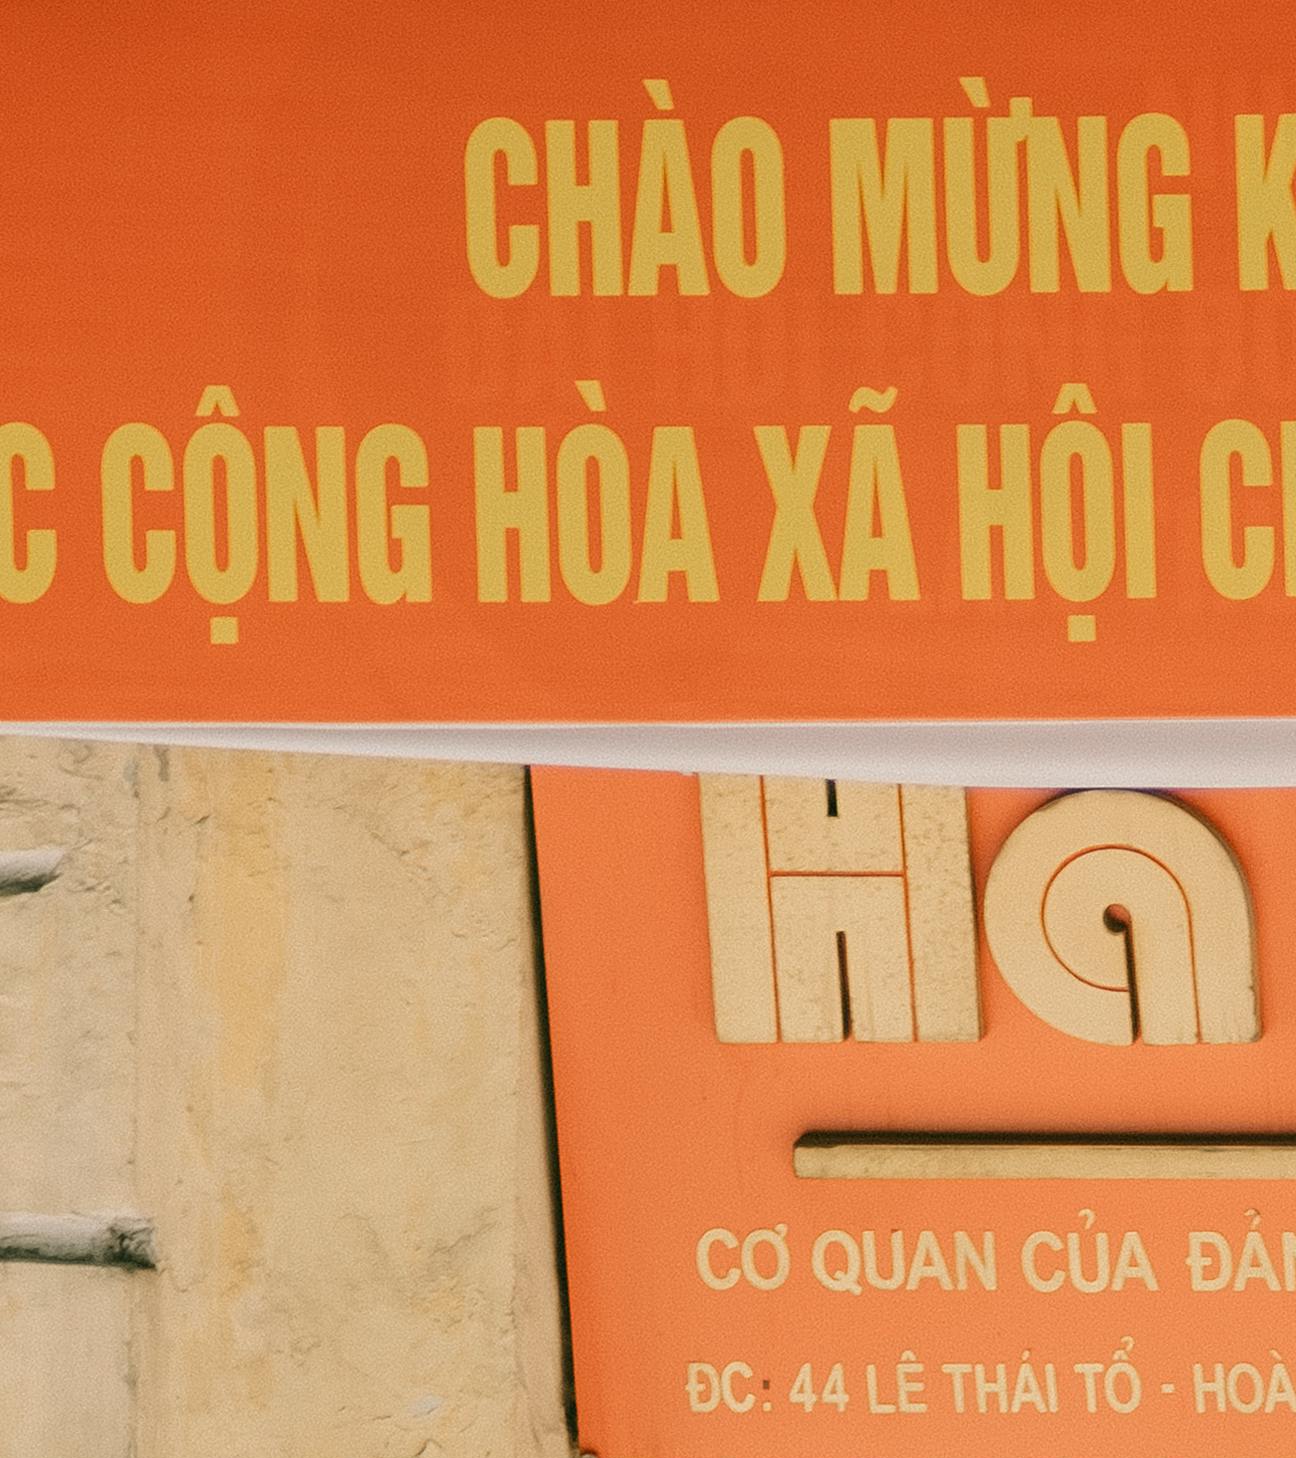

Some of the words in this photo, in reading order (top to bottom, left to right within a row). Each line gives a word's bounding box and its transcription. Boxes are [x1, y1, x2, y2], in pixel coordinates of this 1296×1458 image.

[465, 79, 786, 299] CHÀO
[830, 77, 1193, 297] MỪNG
[101, 385, 433, 645] CỘNG
[473, 379, 720, 606] HÒA
[754, 387, 920, 602] XÃ
[957, 382, 1157, 643] HỘI
[695, 1223, 791, 1291] CƠ
[810, 1228, 998, 1296] QUAN
[1020, 1207, 1159, 1295] CỦA
[685, 1360, 773, 1414] ĐC:
[788, 1362, 850, 1413] 44
[865, 1349, 929, 1415] LÊ
[941, 1348, 1060, 1415] THÁI
[1073, 1335, 1143, 1415] TỔ
